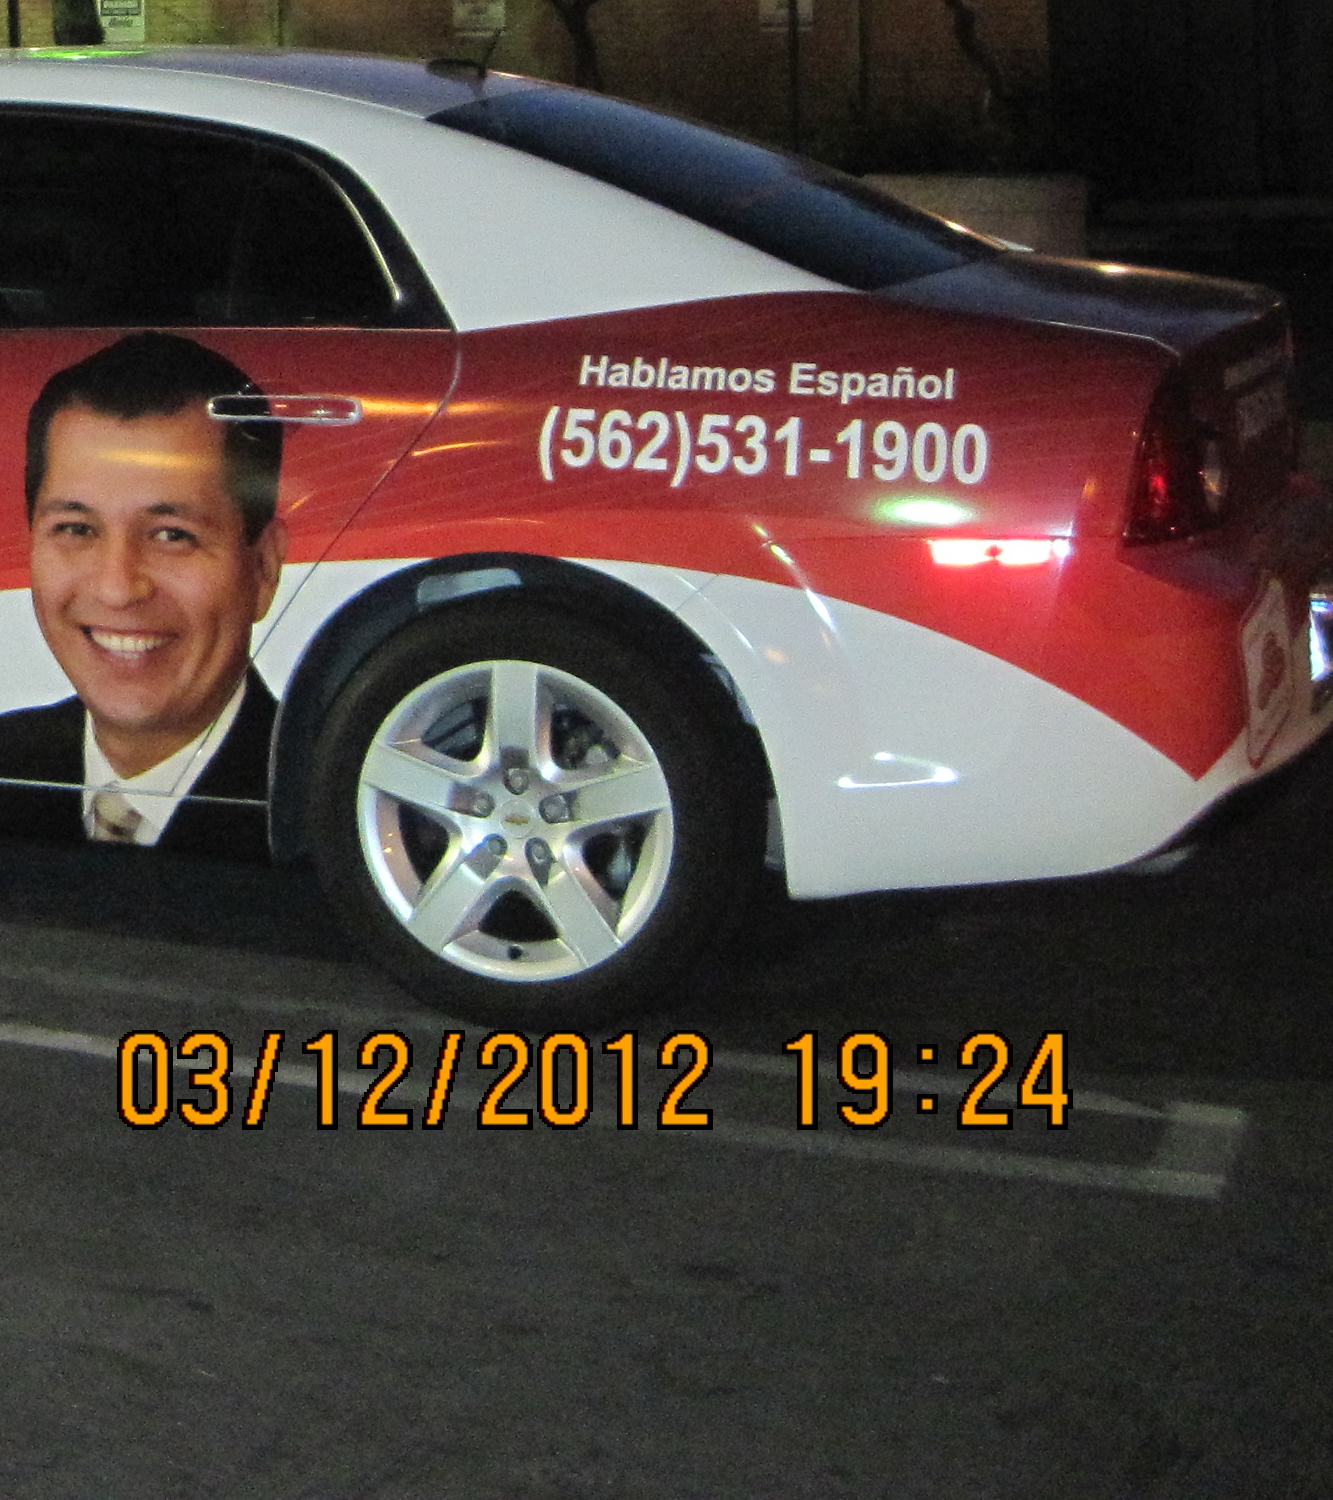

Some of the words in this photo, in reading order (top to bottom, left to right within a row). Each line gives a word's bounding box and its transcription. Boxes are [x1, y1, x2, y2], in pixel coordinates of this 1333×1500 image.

[579, 355, 776, 393] Hablamos
[789, 362, 956, 405] Español
[538, 405, 990, 489] (562)531-1900
